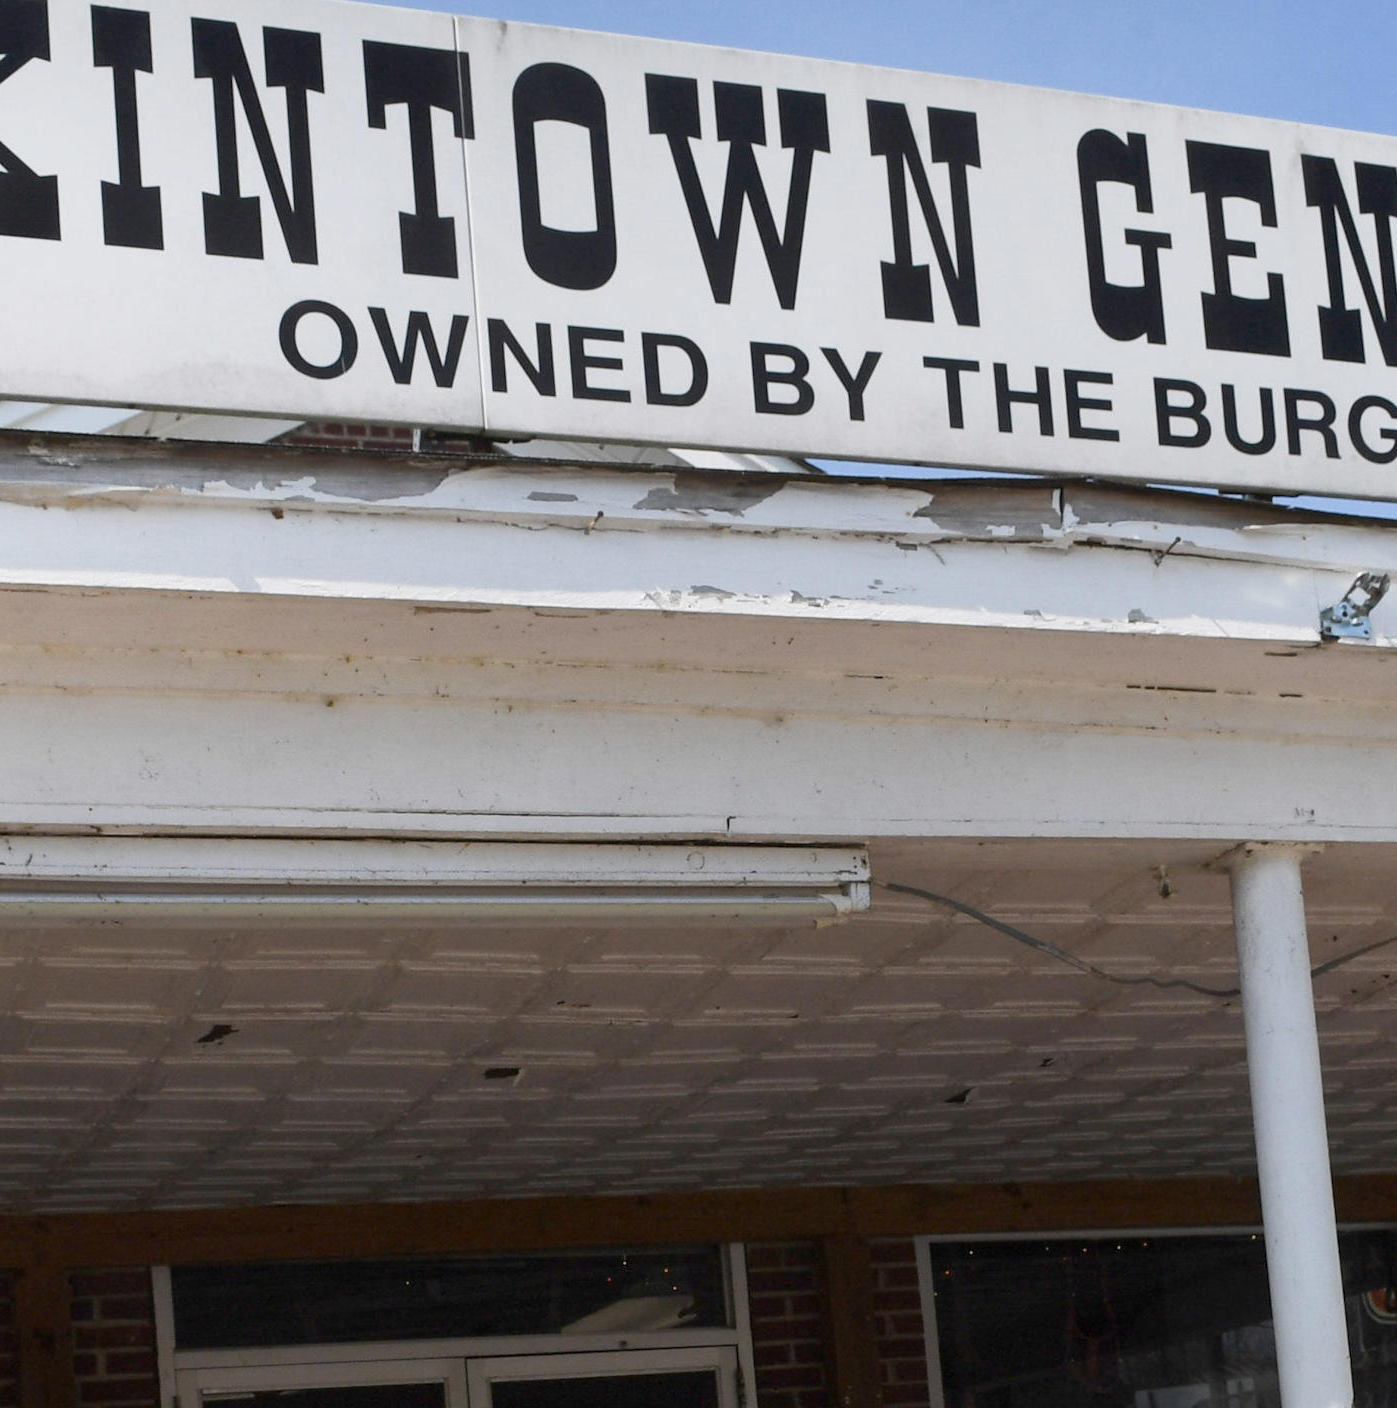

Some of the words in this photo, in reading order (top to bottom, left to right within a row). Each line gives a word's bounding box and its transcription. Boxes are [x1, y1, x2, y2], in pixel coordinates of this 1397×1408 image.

[278, 299, 709, 407] OWNED
[750, 341, 881, 422] BY
[921, 355, 1120, 443] THE
